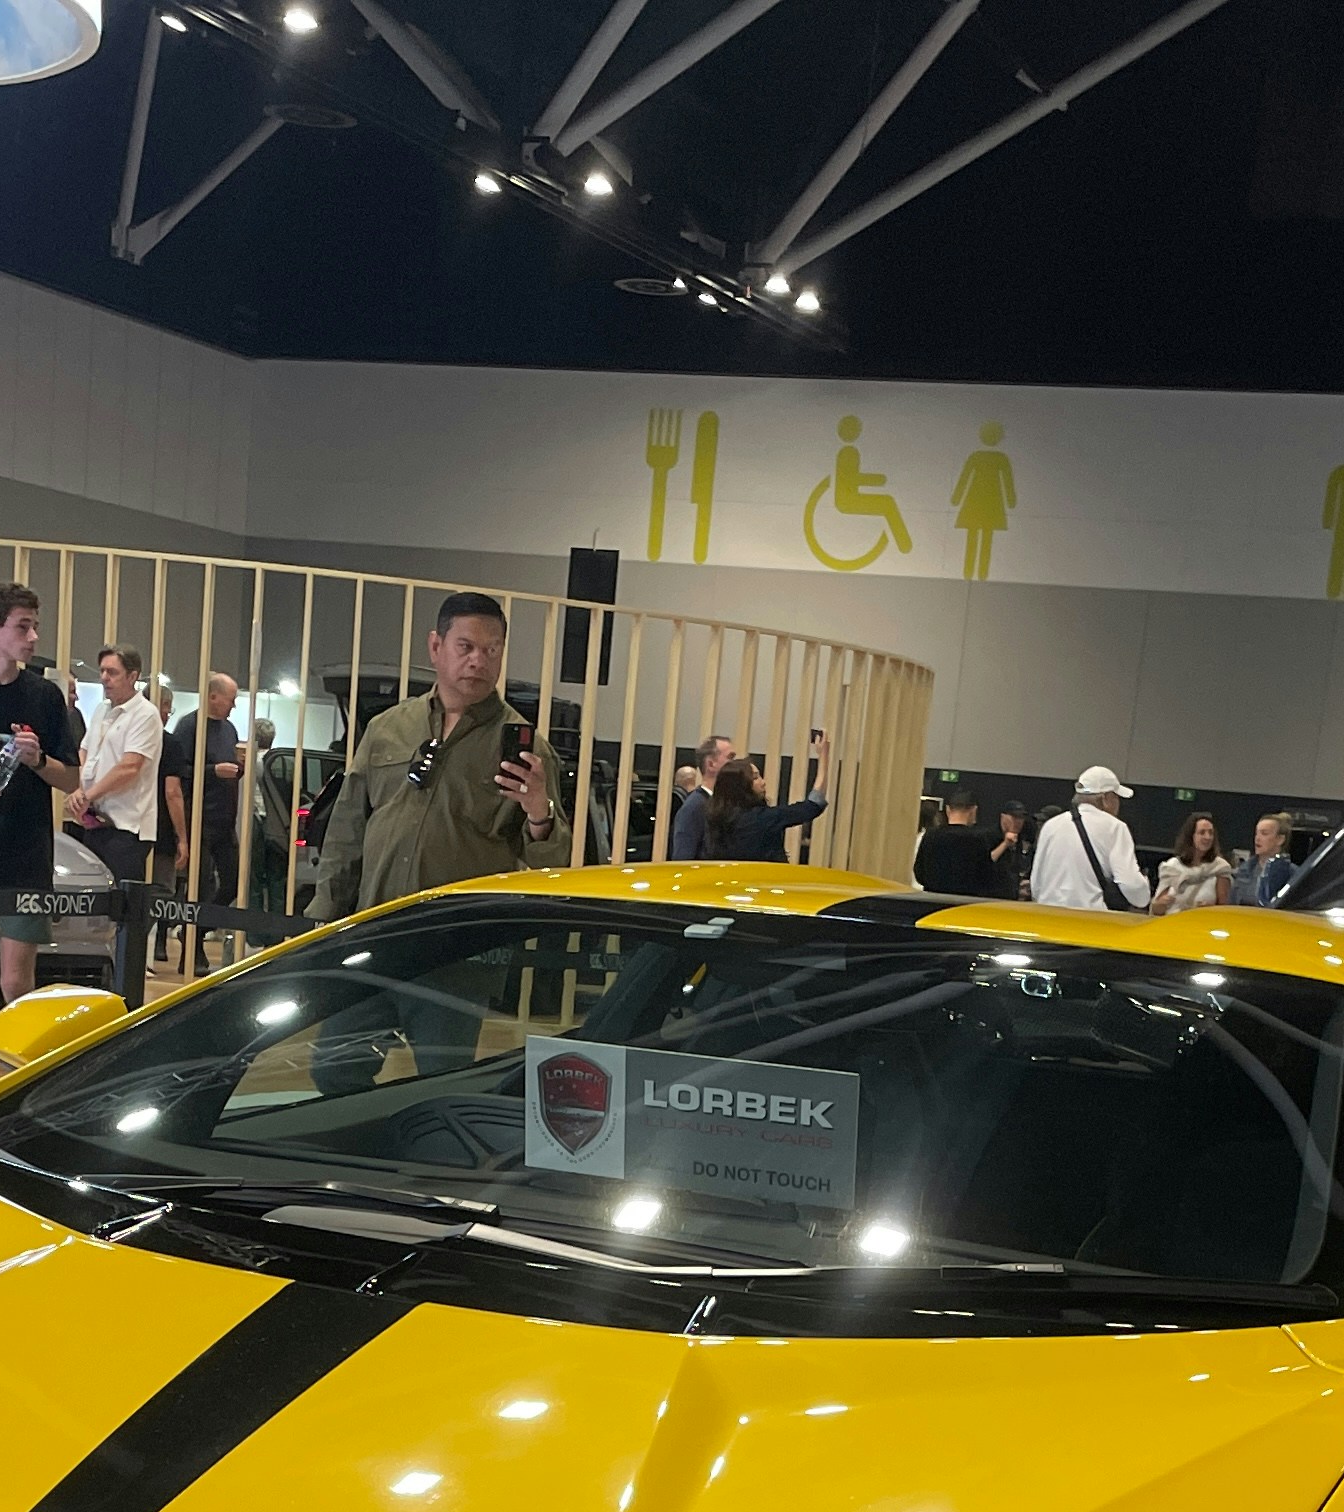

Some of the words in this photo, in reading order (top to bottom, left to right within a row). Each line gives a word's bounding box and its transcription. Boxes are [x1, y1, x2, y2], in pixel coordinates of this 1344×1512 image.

[43, 894, 96, 914] SYDNEY
[154, 898, 202, 922] SYDNEY
[643, 1079, 834, 1130] LORBEK
[644, 1117, 746, 1138] LUXURY
[760, 1129, 834, 1150] CARS
[692, 1160, 719, 1178] DO
[723, 1165, 762, 1184] NOT
[766, 1170, 831, 1193] TOUCH
